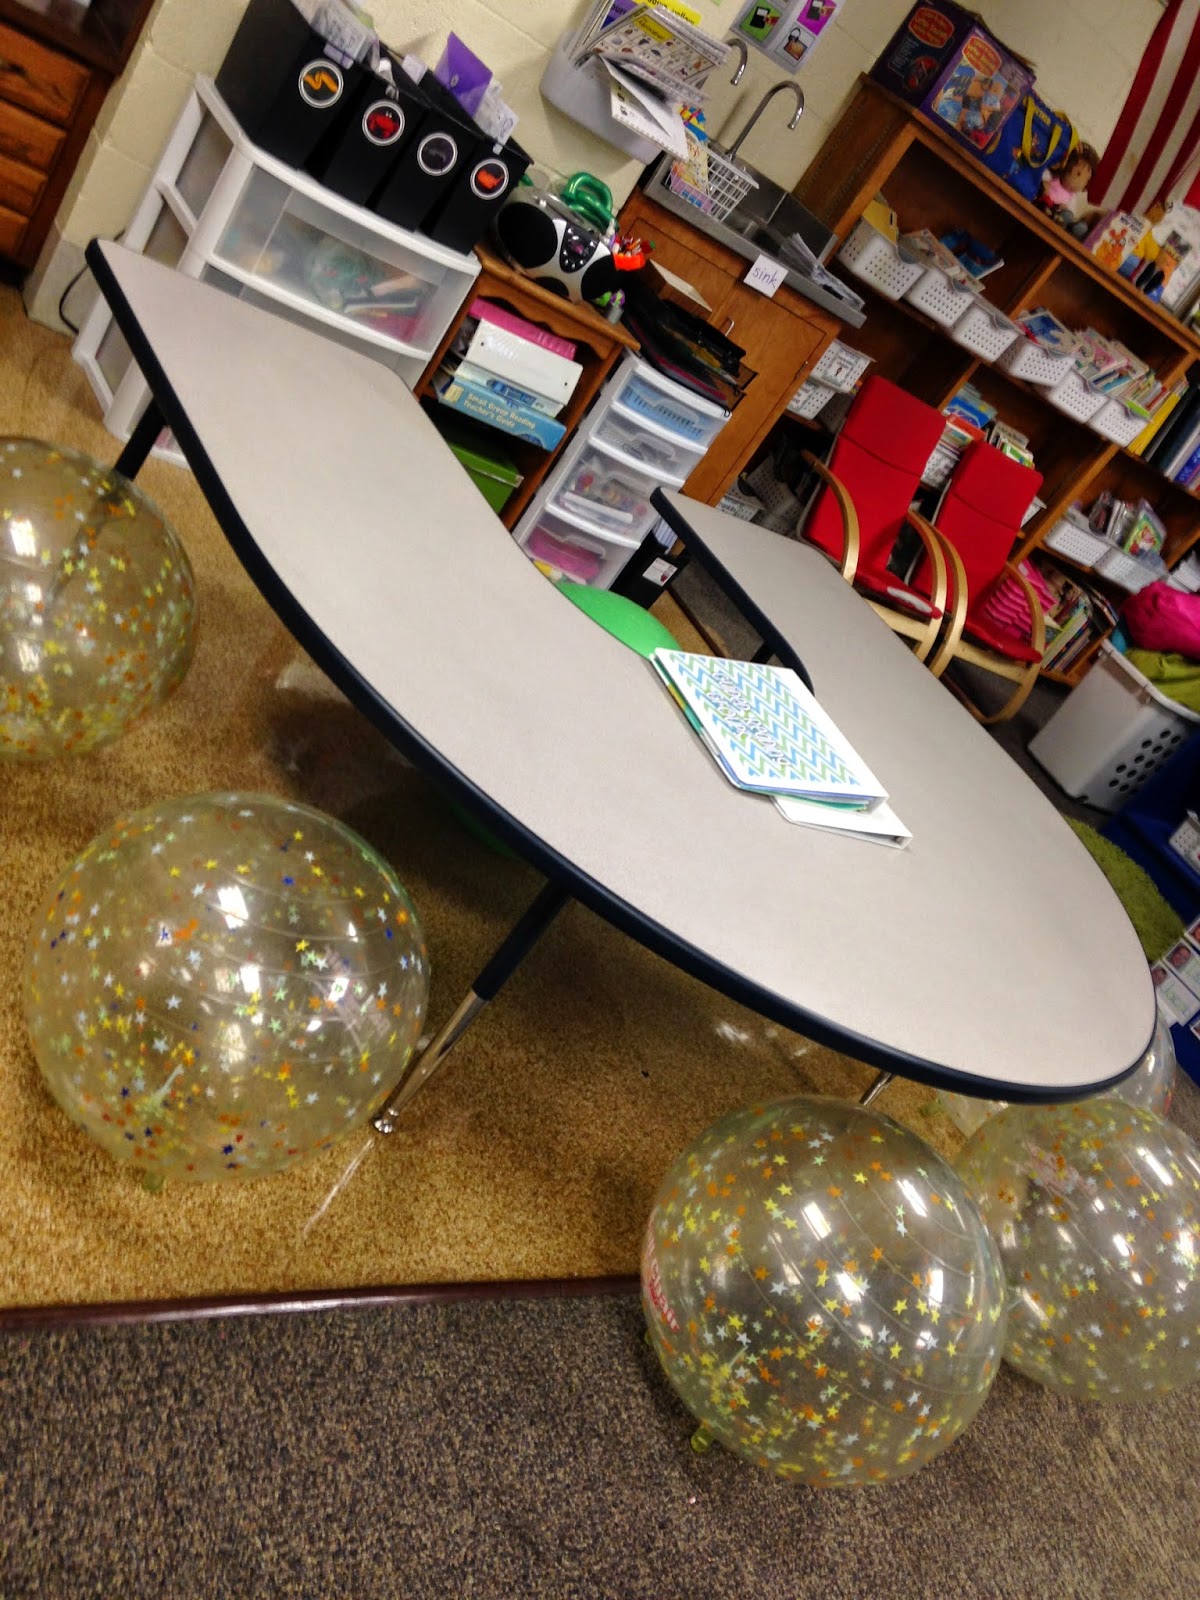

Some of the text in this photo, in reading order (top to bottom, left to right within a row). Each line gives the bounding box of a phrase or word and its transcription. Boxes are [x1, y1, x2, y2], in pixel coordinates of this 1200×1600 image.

[752, 266, 778, 289] sink
[463, 400, 515, 428] Teacher's Guide
[468, 393, 537, 430] Small Group Reading
